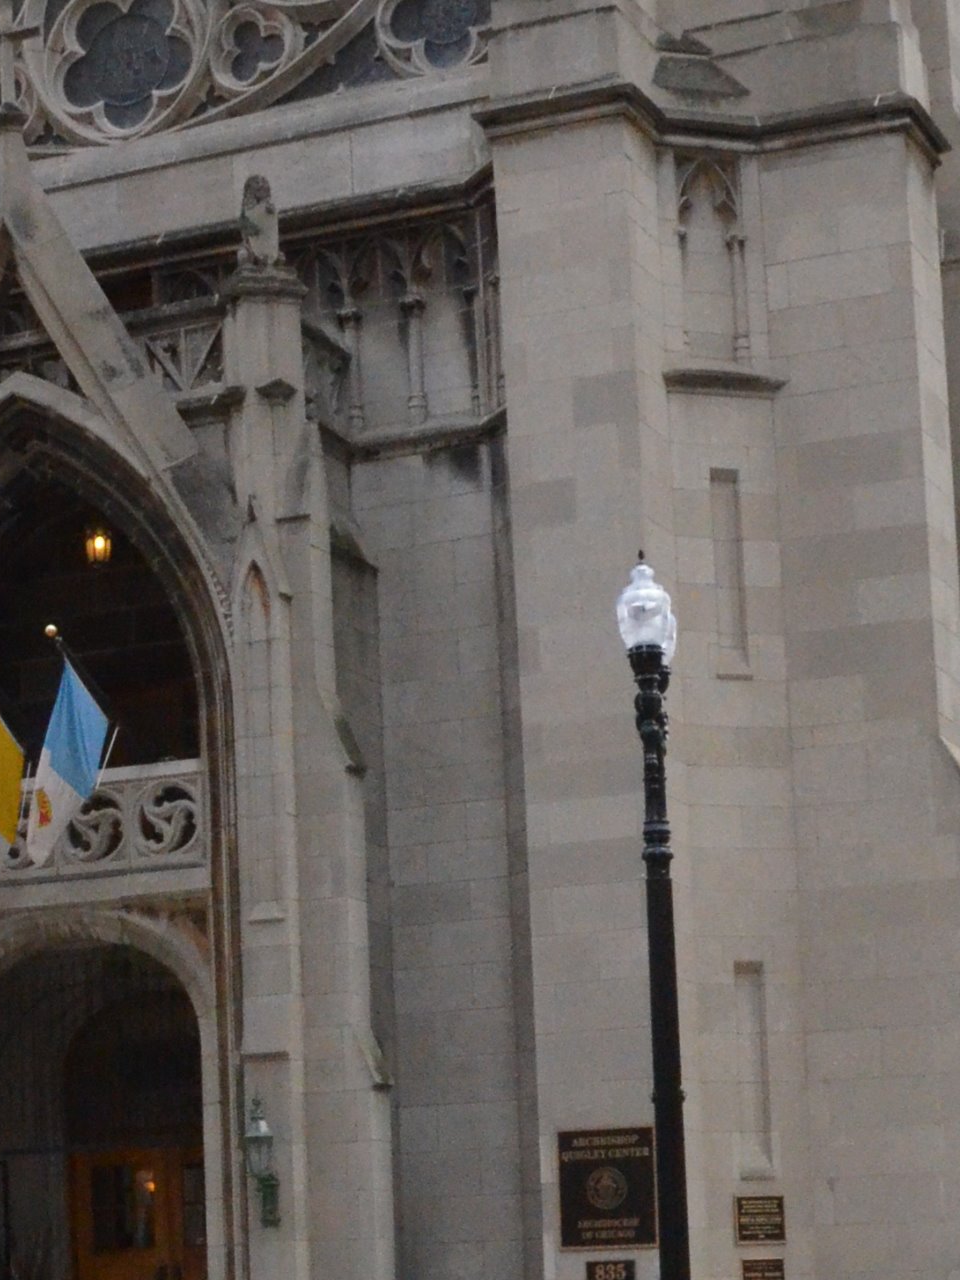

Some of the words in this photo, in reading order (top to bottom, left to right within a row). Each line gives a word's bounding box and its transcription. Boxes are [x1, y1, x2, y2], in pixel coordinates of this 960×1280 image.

[572, 1135, 639, 1147] ARCHBISHOP
[608, 1147, 649, 1159] CENTER
[595, 1263, 626, 1280] 835
